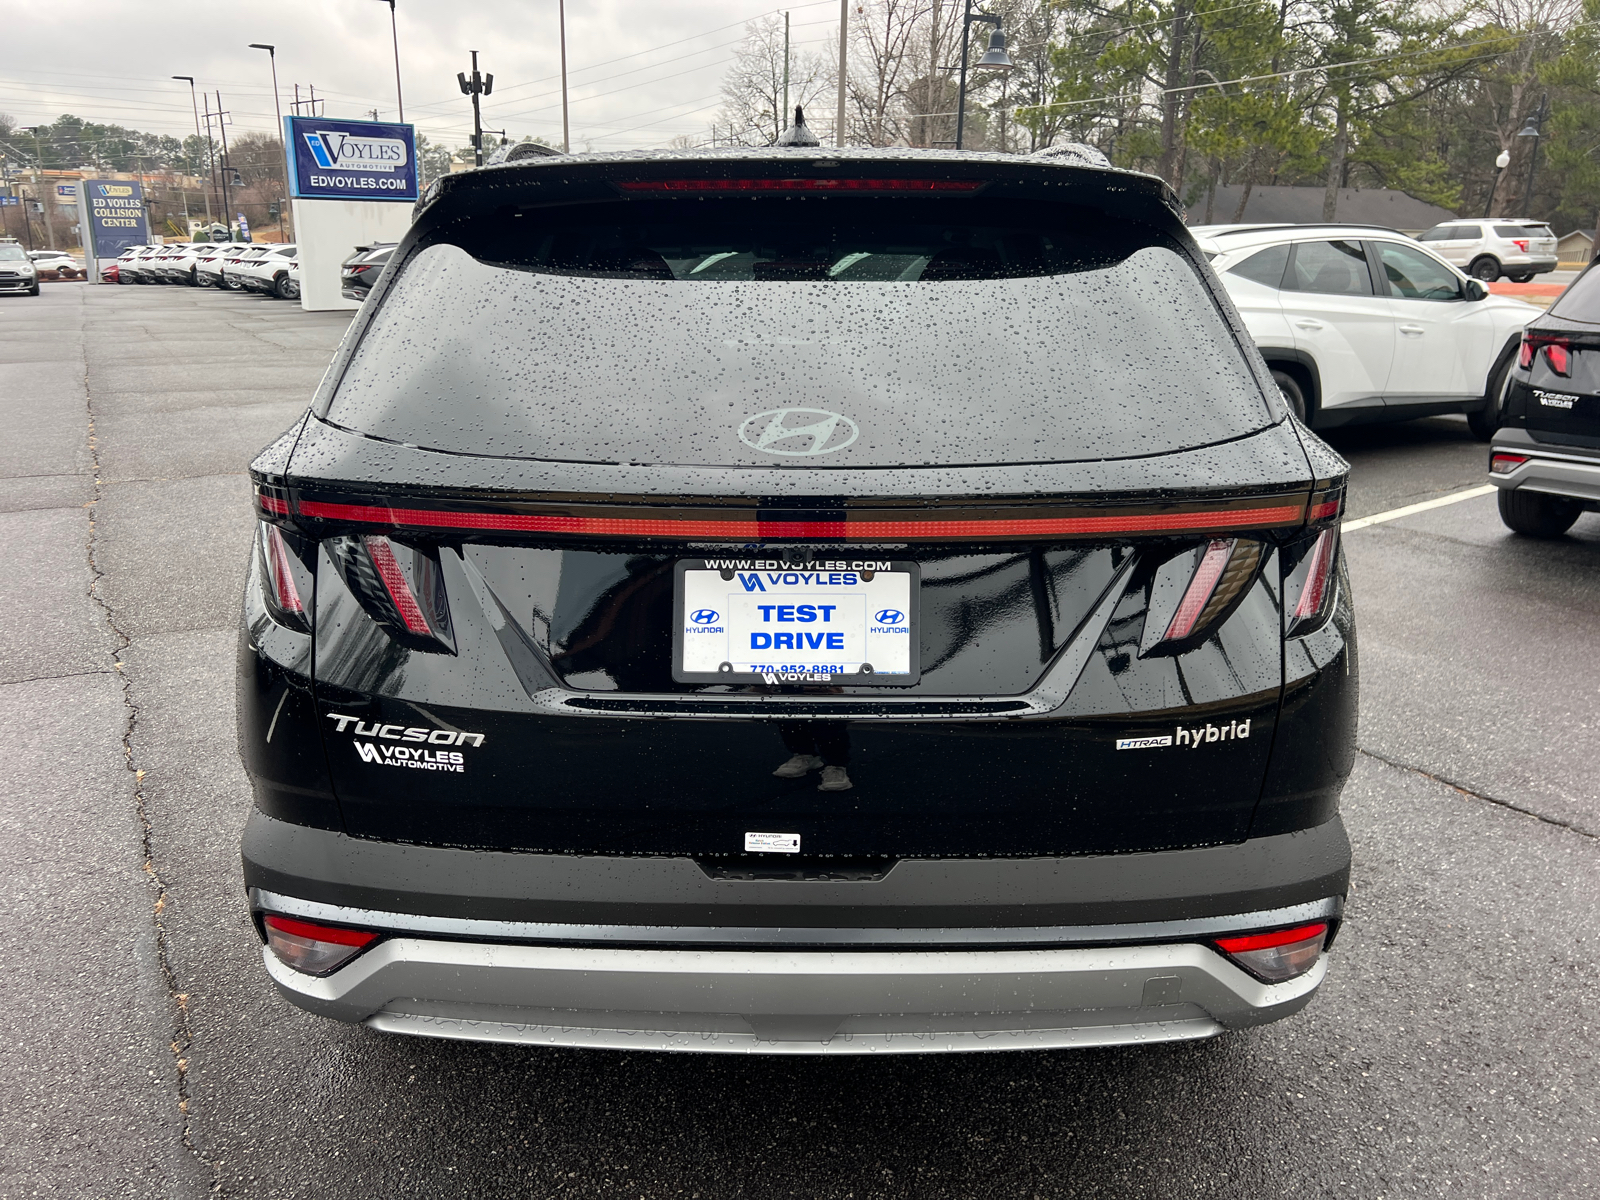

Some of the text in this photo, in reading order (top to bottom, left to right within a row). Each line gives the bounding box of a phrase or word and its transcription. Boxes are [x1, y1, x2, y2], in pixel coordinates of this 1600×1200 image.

[319, 132, 401, 165] VOYLES
[310, 175, 407, 190] EDVOYLES.COM
[92, 198, 141, 208] ED VOYLES
[94, 208, 142, 218] COLLISION
[101, 218, 138, 228] CENTER
[767, 572, 858, 586] VOYLES
[757, 605, 837, 623] TEST
[685, 626, 725, 634] HYUNDAI
[750, 632, 845, 650] DRIVE
[750, 664, 845, 674] 770-952-8881
[778, 672, 832, 682] VOYLES
[1120, 718, 1251, 749] HTRAC hybrid
[379, 744, 465, 764] VOYLES
[383, 757, 465, 773] AUTOMOTIVE
